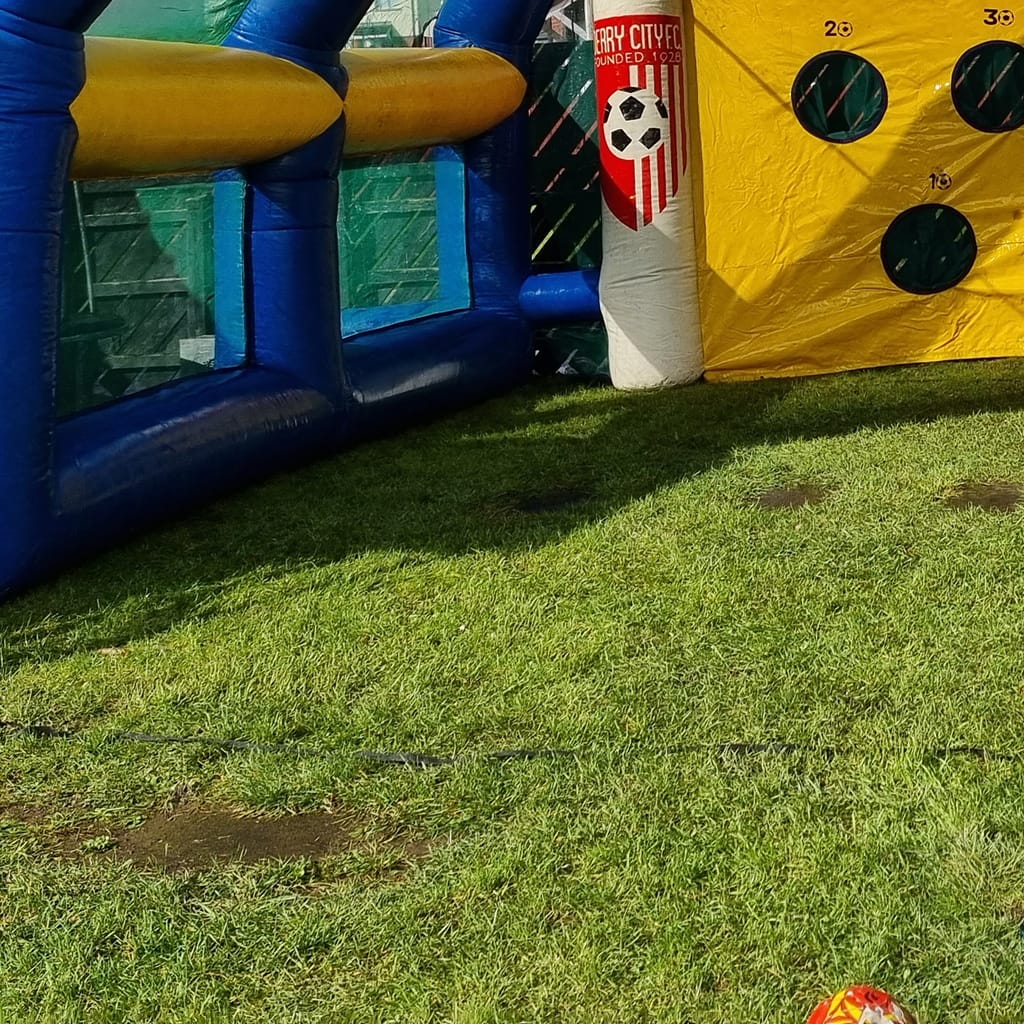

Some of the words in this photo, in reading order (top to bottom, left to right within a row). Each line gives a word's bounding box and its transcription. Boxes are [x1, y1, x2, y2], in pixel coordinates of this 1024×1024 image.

[594, 25, 624, 55] ERRY
[629, 24, 663, 49] CITY
[595, 52, 644, 67] OUNDED
[653, 51, 682, 63] 1928
